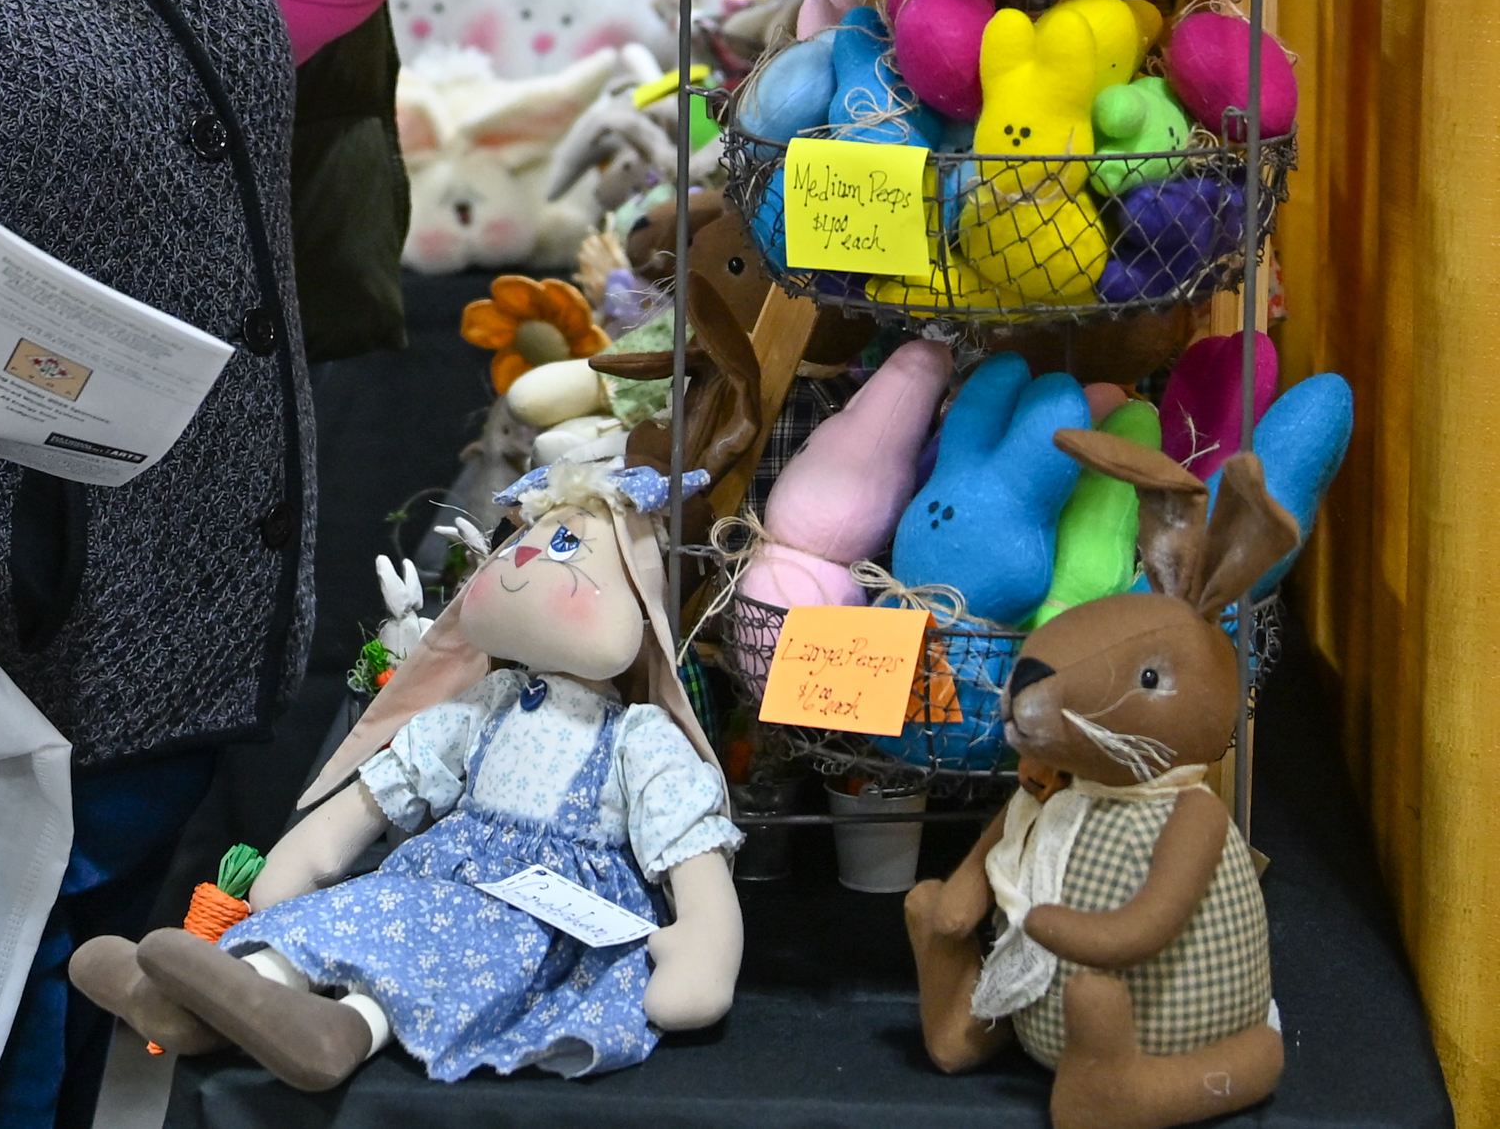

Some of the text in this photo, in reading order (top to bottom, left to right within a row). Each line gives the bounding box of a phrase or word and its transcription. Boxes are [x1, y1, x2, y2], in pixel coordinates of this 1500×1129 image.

[793, 162, 912, 214] Medium Peeps
[841, 224, 886, 252] each
[781, 636, 904, 678] Large Peeps
[819, 691, 863, 720] each
